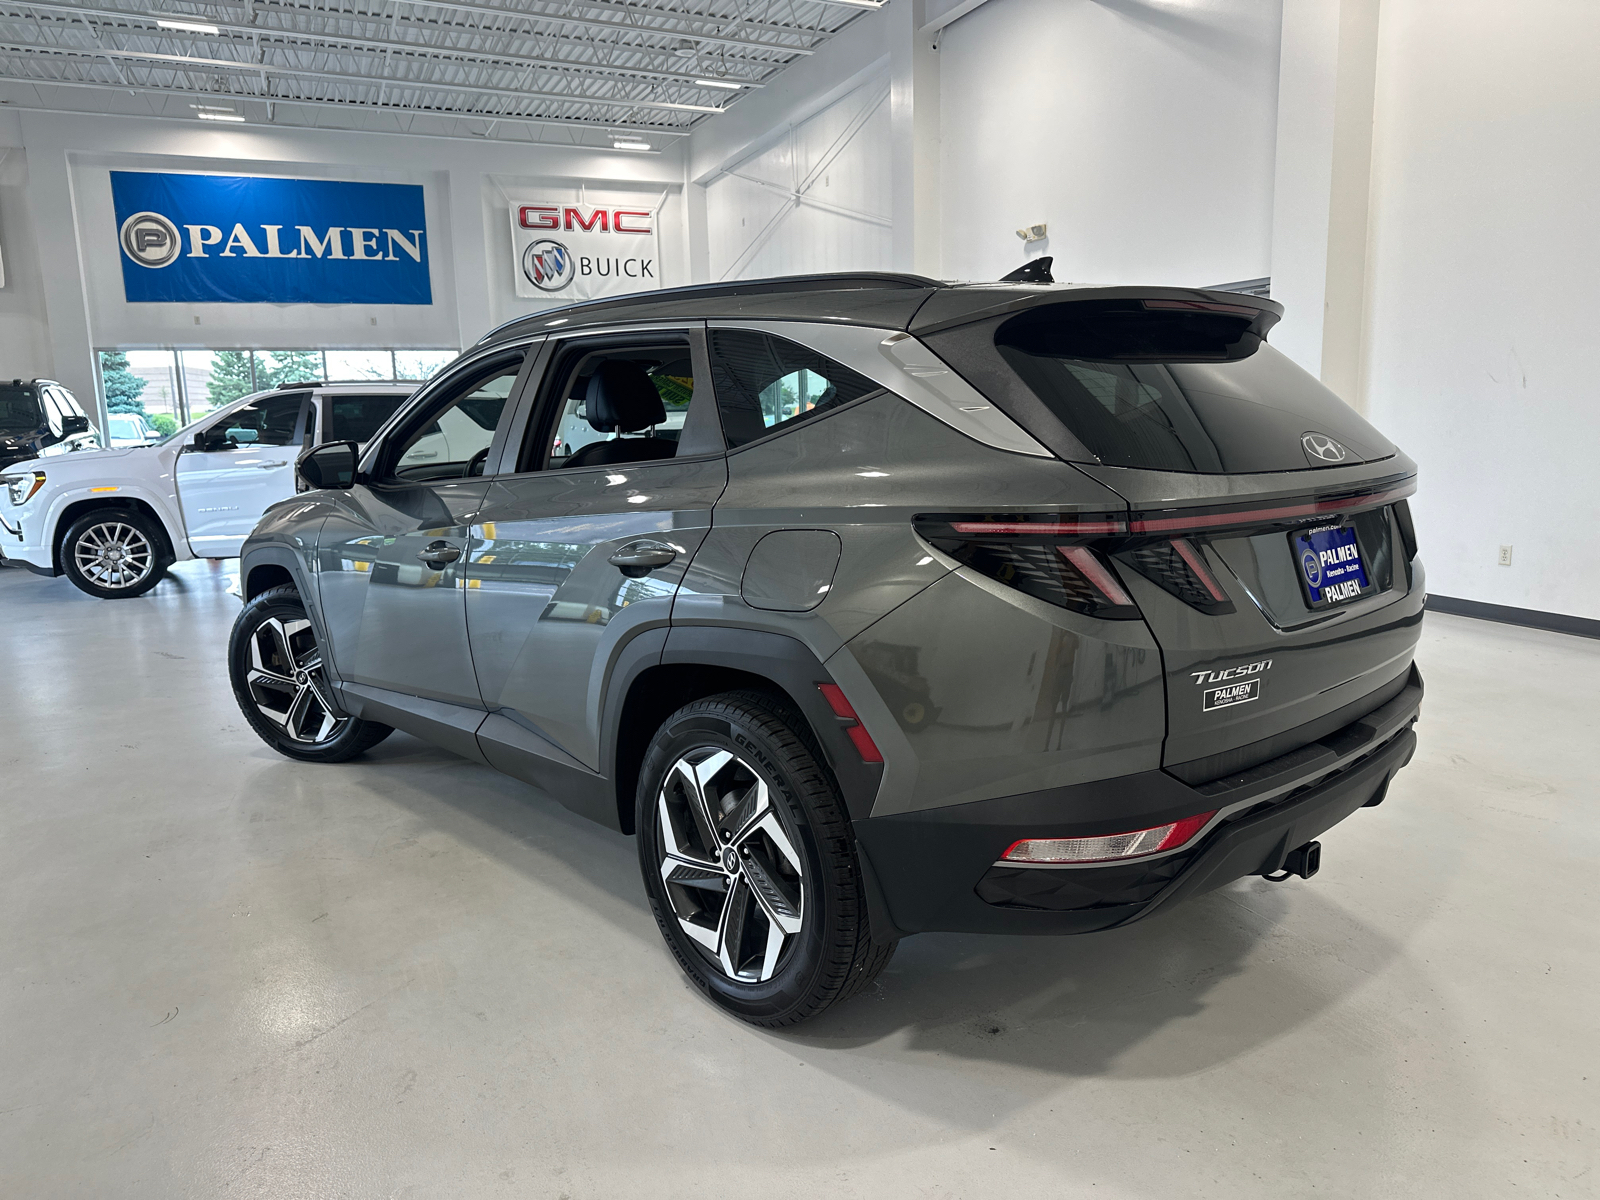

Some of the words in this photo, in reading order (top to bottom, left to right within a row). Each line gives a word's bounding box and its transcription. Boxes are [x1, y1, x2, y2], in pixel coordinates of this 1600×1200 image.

[517, 204, 653, 236] GMC
[183, 222, 424, 263] PALMEN
[580, 256, 654, 278] BUICK
[1319, 543, 1359, 568] PALMEN
[1324, 579, 1361, 603] PALMEN
[1190, 659, 1273, 685] TUCSON
[1213, 684, 1252, 701] PALMEN
[734, 733, 800, 819] GENERAL
[664, 931, 706, 988] GRABBER
